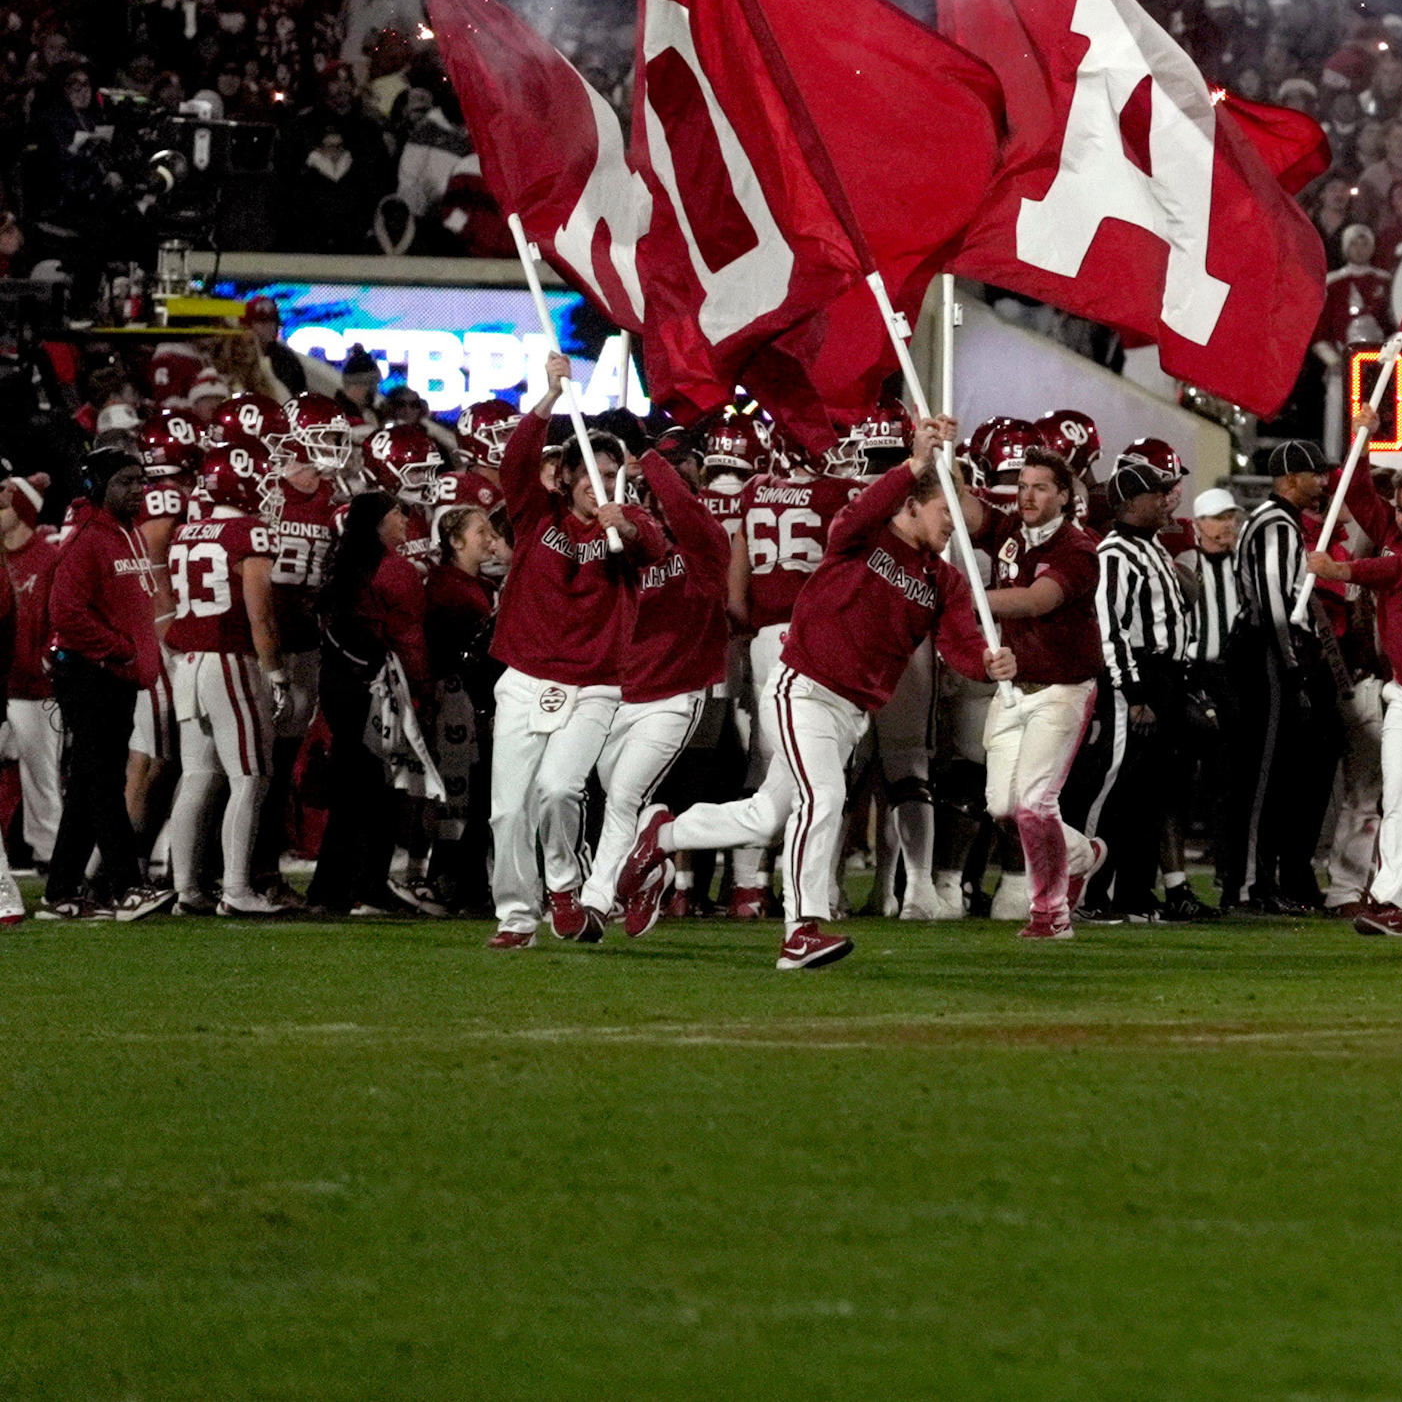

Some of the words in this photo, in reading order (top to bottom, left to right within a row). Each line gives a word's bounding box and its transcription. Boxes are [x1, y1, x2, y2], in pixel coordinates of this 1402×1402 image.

[145, 490, 182, 516] 86
[754, 486, 813, 507] SIMMONS
[177, 522, 227, 541] NELSON
[250, 526, 281, 553] 83
[745, 507, 824, 575] 66
